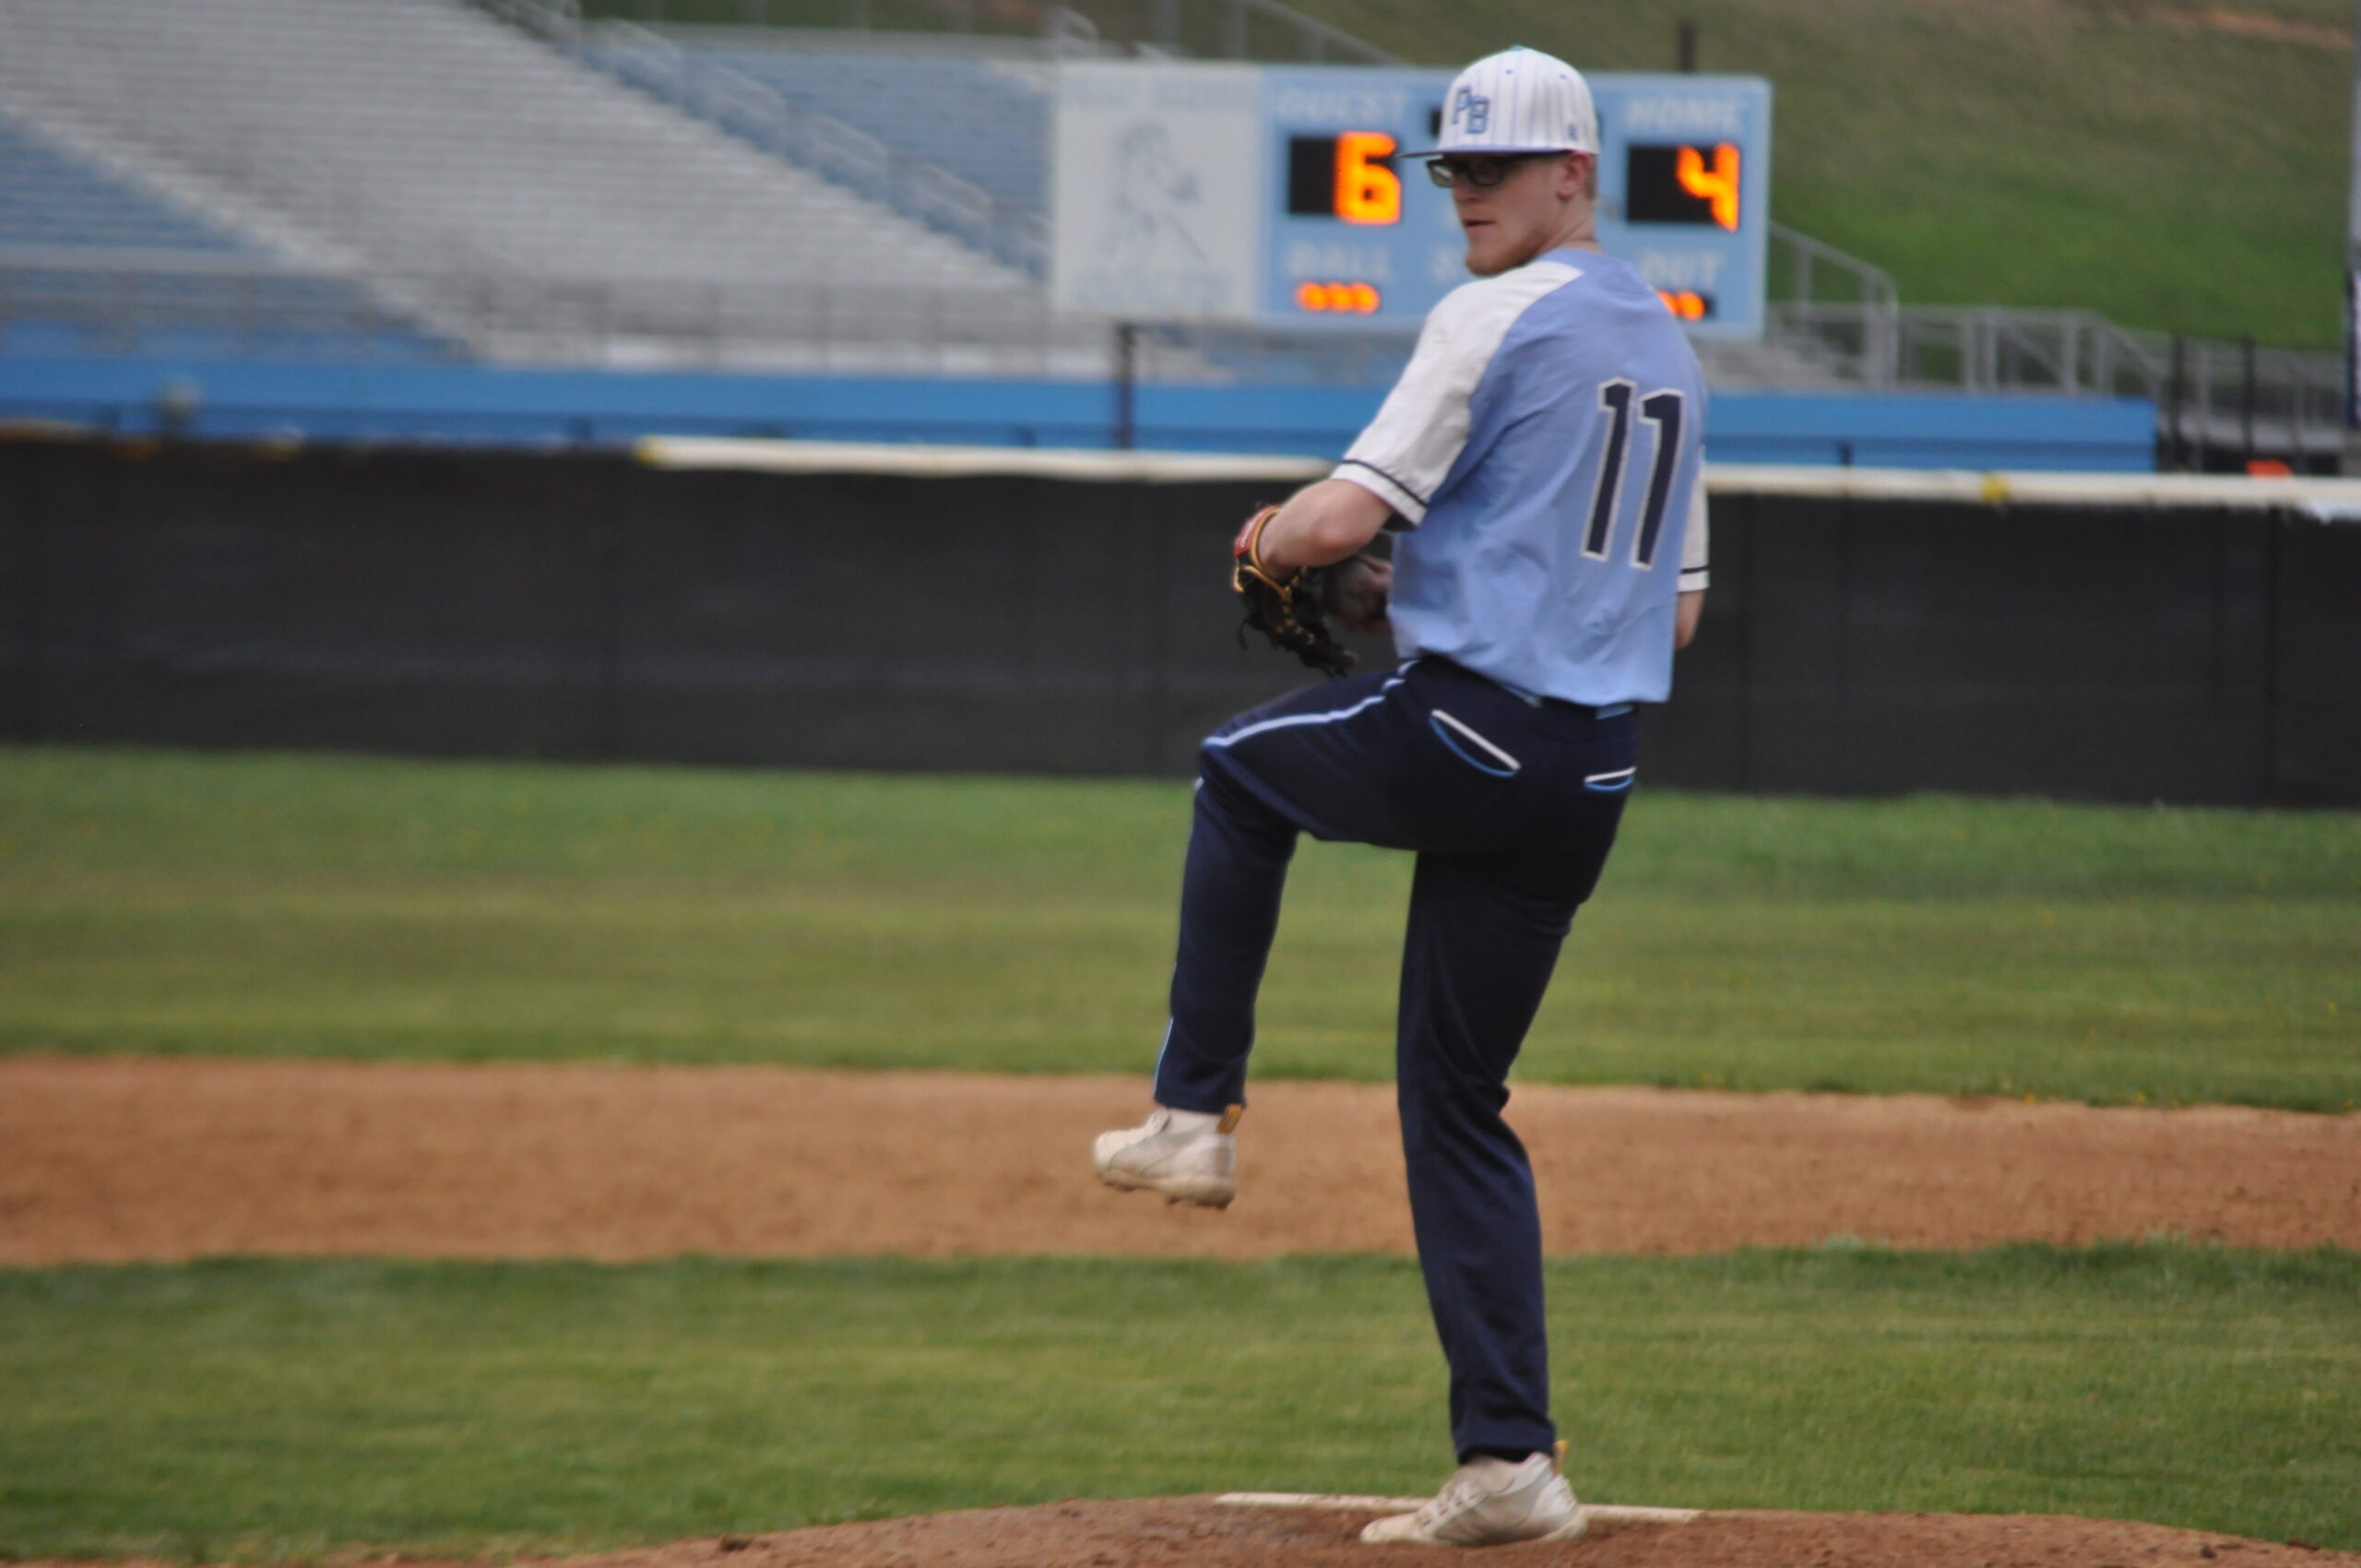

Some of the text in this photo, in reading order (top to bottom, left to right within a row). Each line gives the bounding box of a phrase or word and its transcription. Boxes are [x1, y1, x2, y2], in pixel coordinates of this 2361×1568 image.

[1452, 85, 1489, 134] PB
[1333, 129, 1403, 226] 6
[1676, 140, 1741, 232] 4
[1580, 377, 1686, 572] 11
